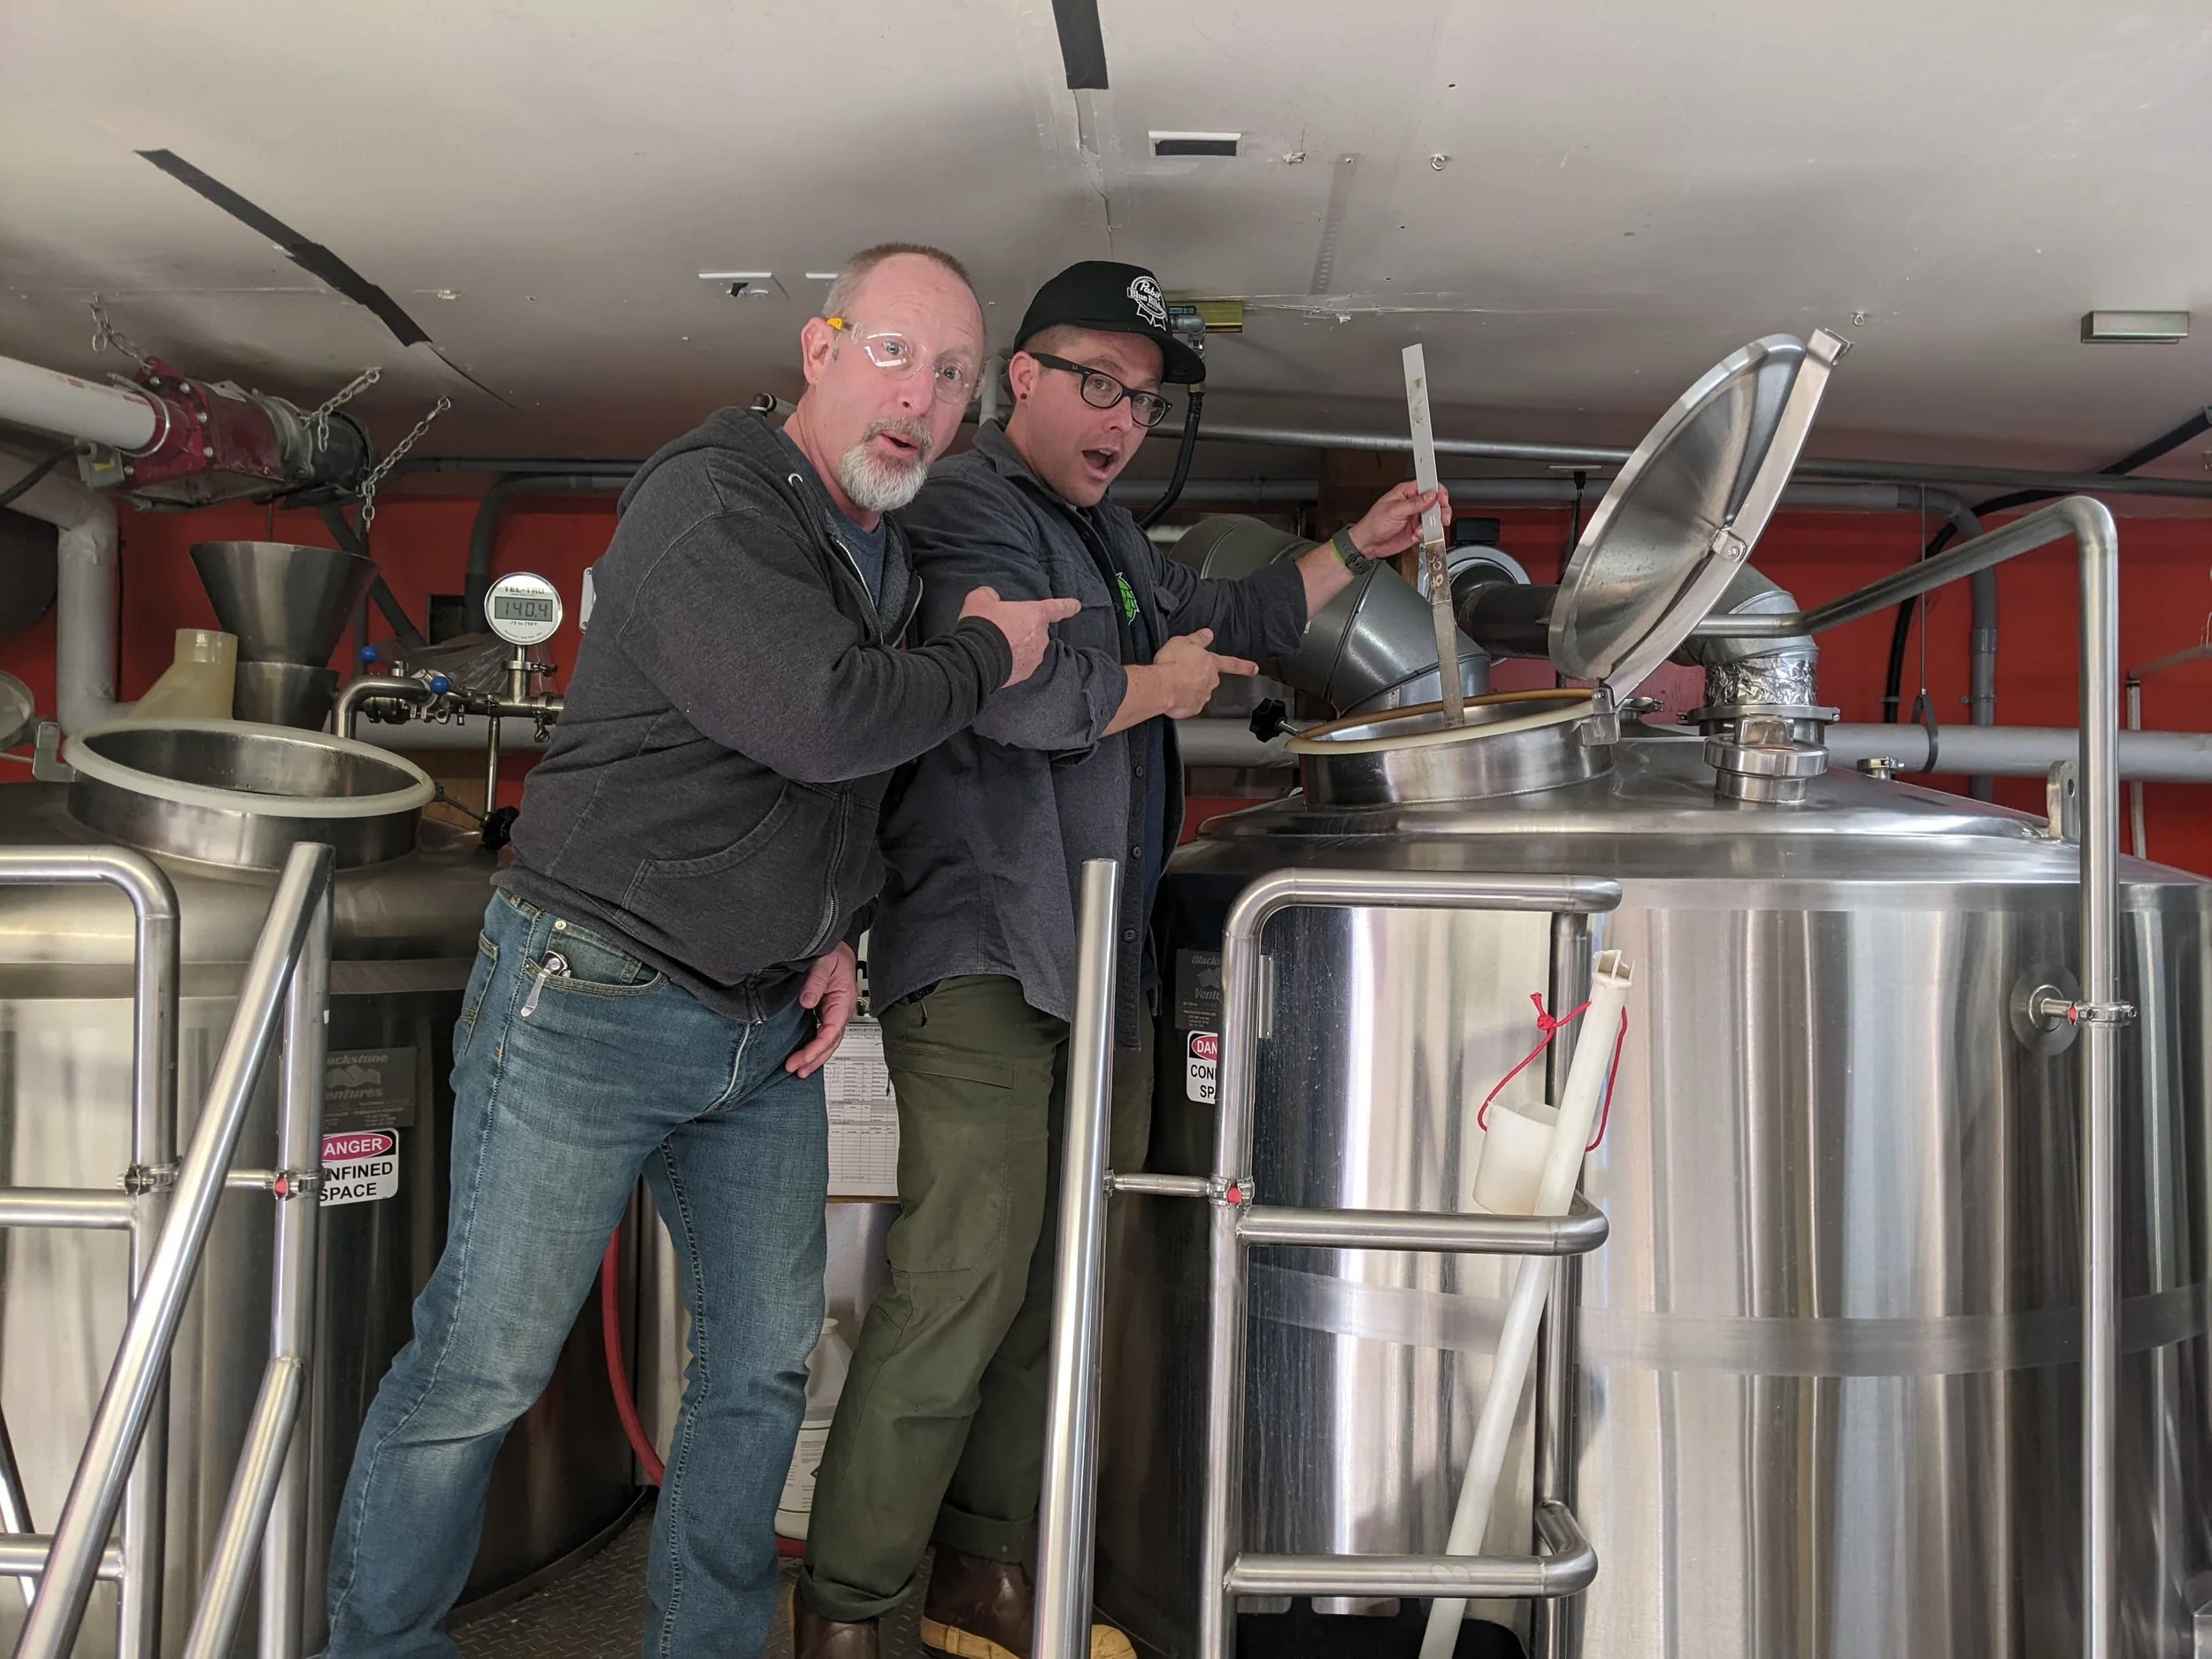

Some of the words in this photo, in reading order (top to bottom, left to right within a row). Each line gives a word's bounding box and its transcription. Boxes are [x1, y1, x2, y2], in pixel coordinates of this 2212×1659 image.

[1130, 289, 1148, 302] Blue
[1140, 282, 1161, 302] Pabst
[505, 602, 549, 618] 140.4
[1191, 955, 1221, 966] Blacks
[1196, 1040, 1217, 1055] DAN
[326, 1054, 388, 1065] ackstone
[1191, 1064, 1217, 1080] CON
[326, 1088, 384, 1101] entures
[1200, 1085, 1215, 1098] SP
[323, 1138, 383, 1156] ANGER
[330, 1162, 393, 1180] NFINED
